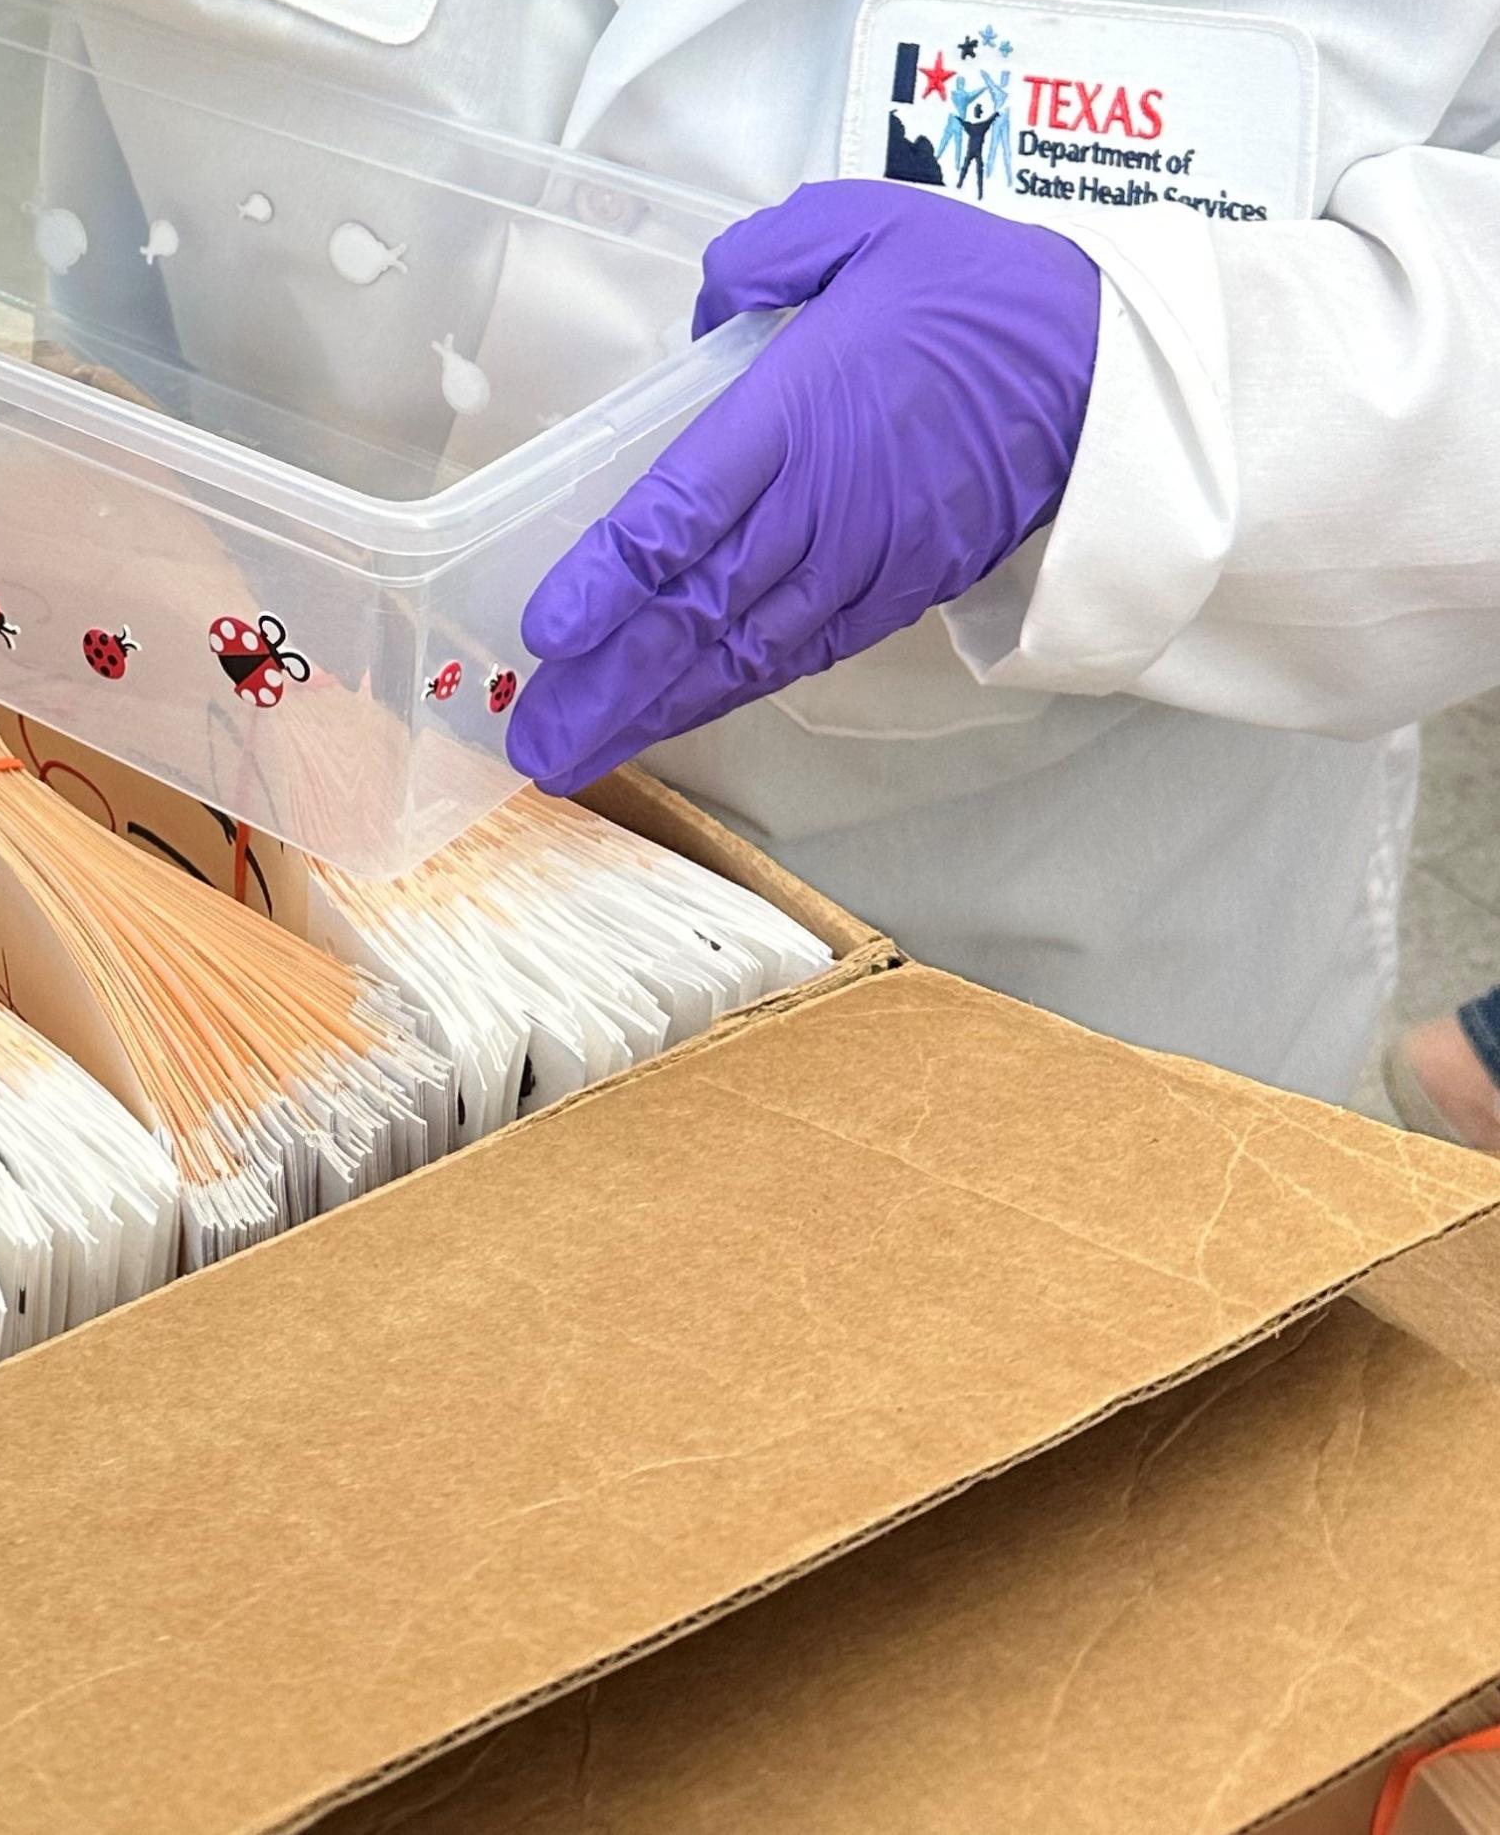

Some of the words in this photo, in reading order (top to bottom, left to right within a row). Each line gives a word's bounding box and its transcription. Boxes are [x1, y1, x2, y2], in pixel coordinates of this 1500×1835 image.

[1022, 74, 1164, 141] TEXAS
[1017, 129, 1162, 174] Department
[1165, 149, 1196, 176] of
[1015, 168, 1076, 203] State
[1077, 174, 1159, 206] Health
